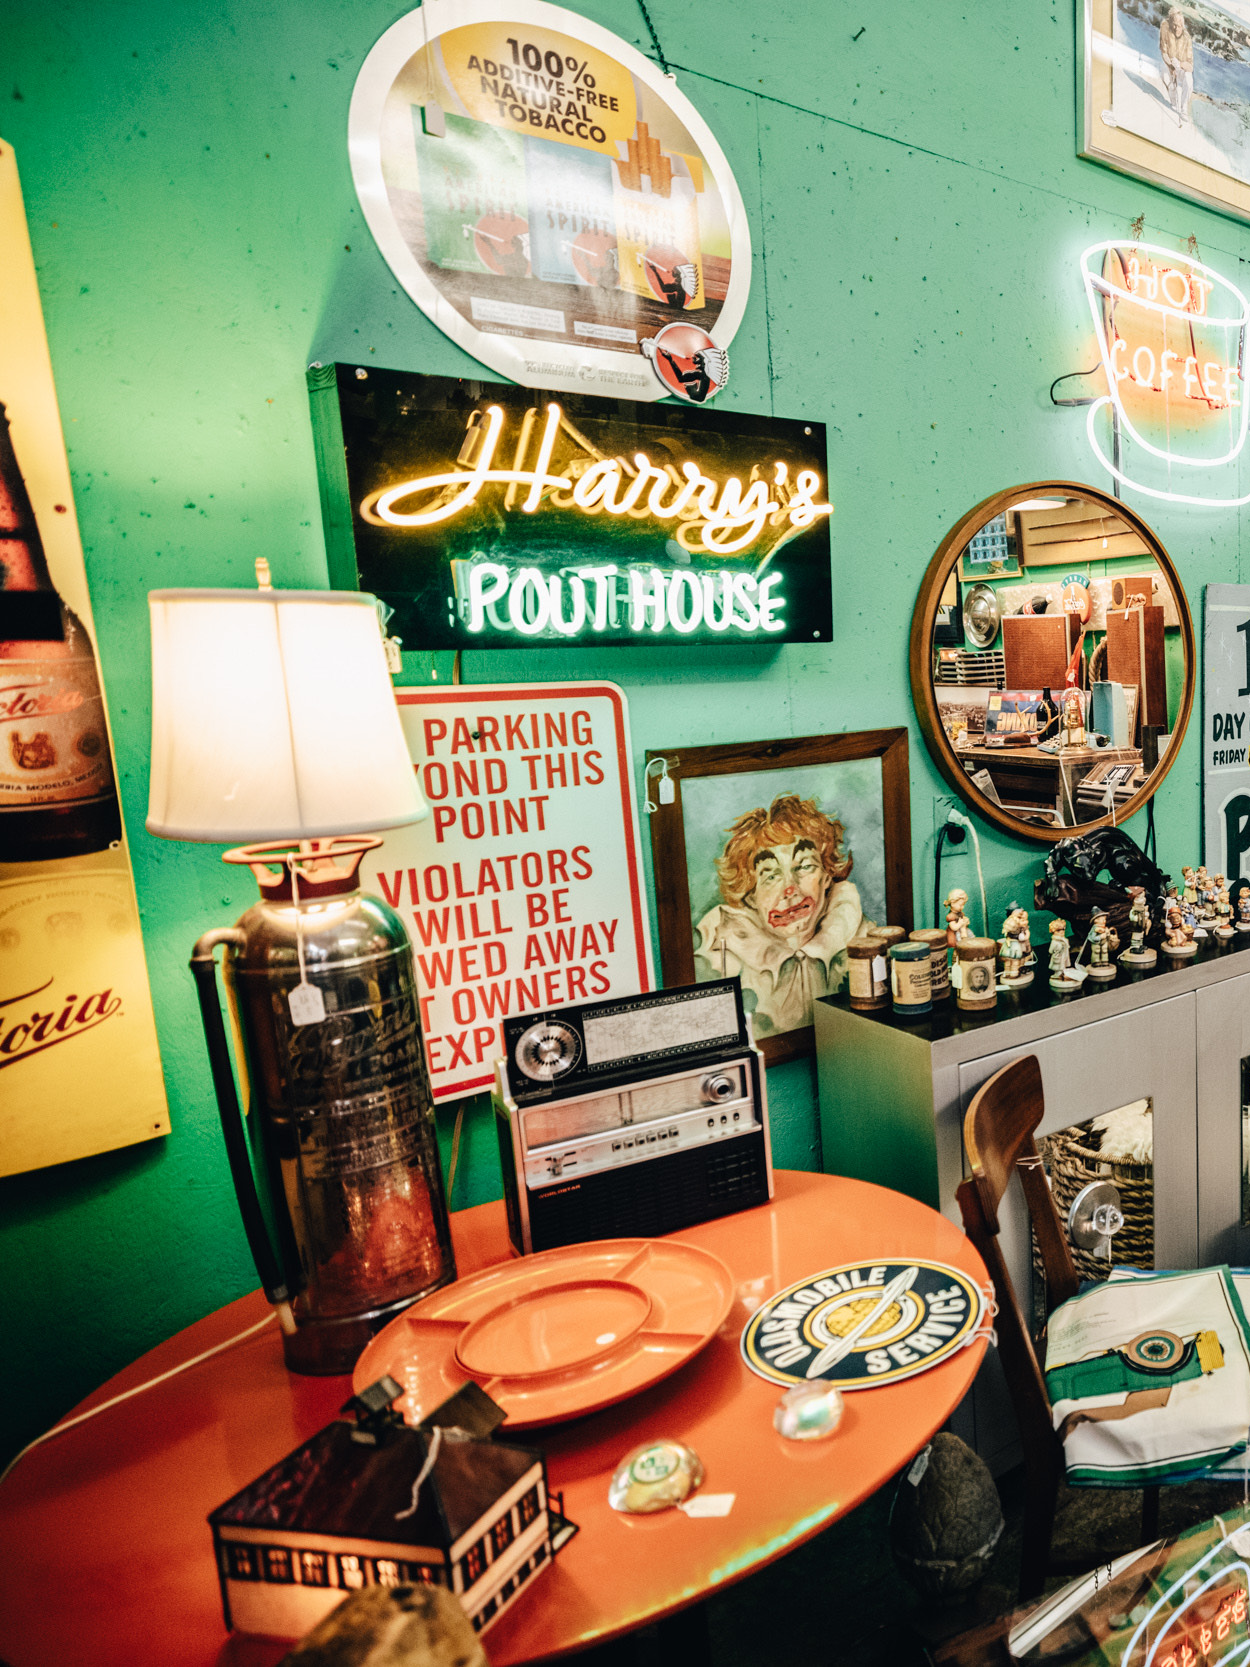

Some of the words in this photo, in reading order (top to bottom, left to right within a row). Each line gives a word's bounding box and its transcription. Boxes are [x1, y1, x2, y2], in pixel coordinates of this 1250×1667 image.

[466, 55, 619, 112] ADDITIVE-FREE
[506, 38, 596, 88] 100%
[481, 75, 593, 122] NATURAL
[494, 98, 607, 144] TOBACCO
[1128, 257, 1214, 315] HOT
[1110, 339, 1242, 406] COFFEE
[376, 402, 834, 554] Harry's
[422, 710, 594, 756] PARKING
[1213, 713, 1246, 742] DAY
[413, 754, 509, 800] OND
[521, 751, 606, 791] THIS
[1213, 748, 1246, 766] FRIDAY
[432, 796, 551, 844] POINT
[377, 845, 594, 909] VIOLATORS
[413, 901, 513, 948] WILL
[526, 888, 573, 929] BE
[523, 919, 620, 971] AWAY
[0, 988, 122, 1054] oria
[453, 961, 612, 1026] OWNERS
[760, 1266, 887, 1368] OLDSMOBILE
[865, 1285, 966, 1374] SERVICE
